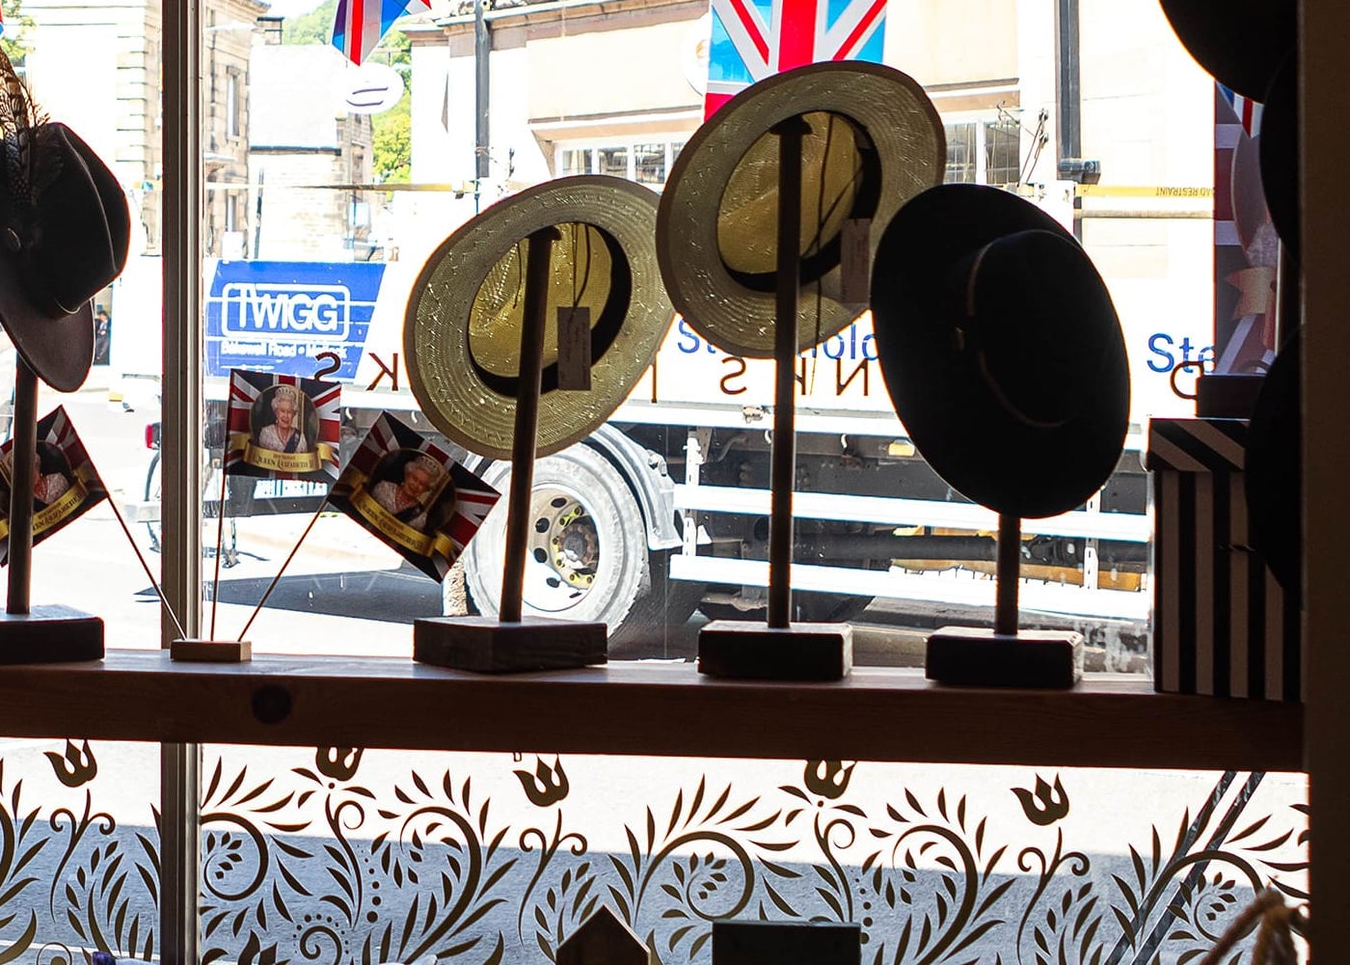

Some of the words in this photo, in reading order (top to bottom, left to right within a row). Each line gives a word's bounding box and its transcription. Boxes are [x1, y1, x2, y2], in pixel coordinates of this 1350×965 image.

[1155, 186, 1199, 197] RESTRAINT
[229, 283, 340, 332] TWIGG
[1146, 332, 1215, 373] Ste
